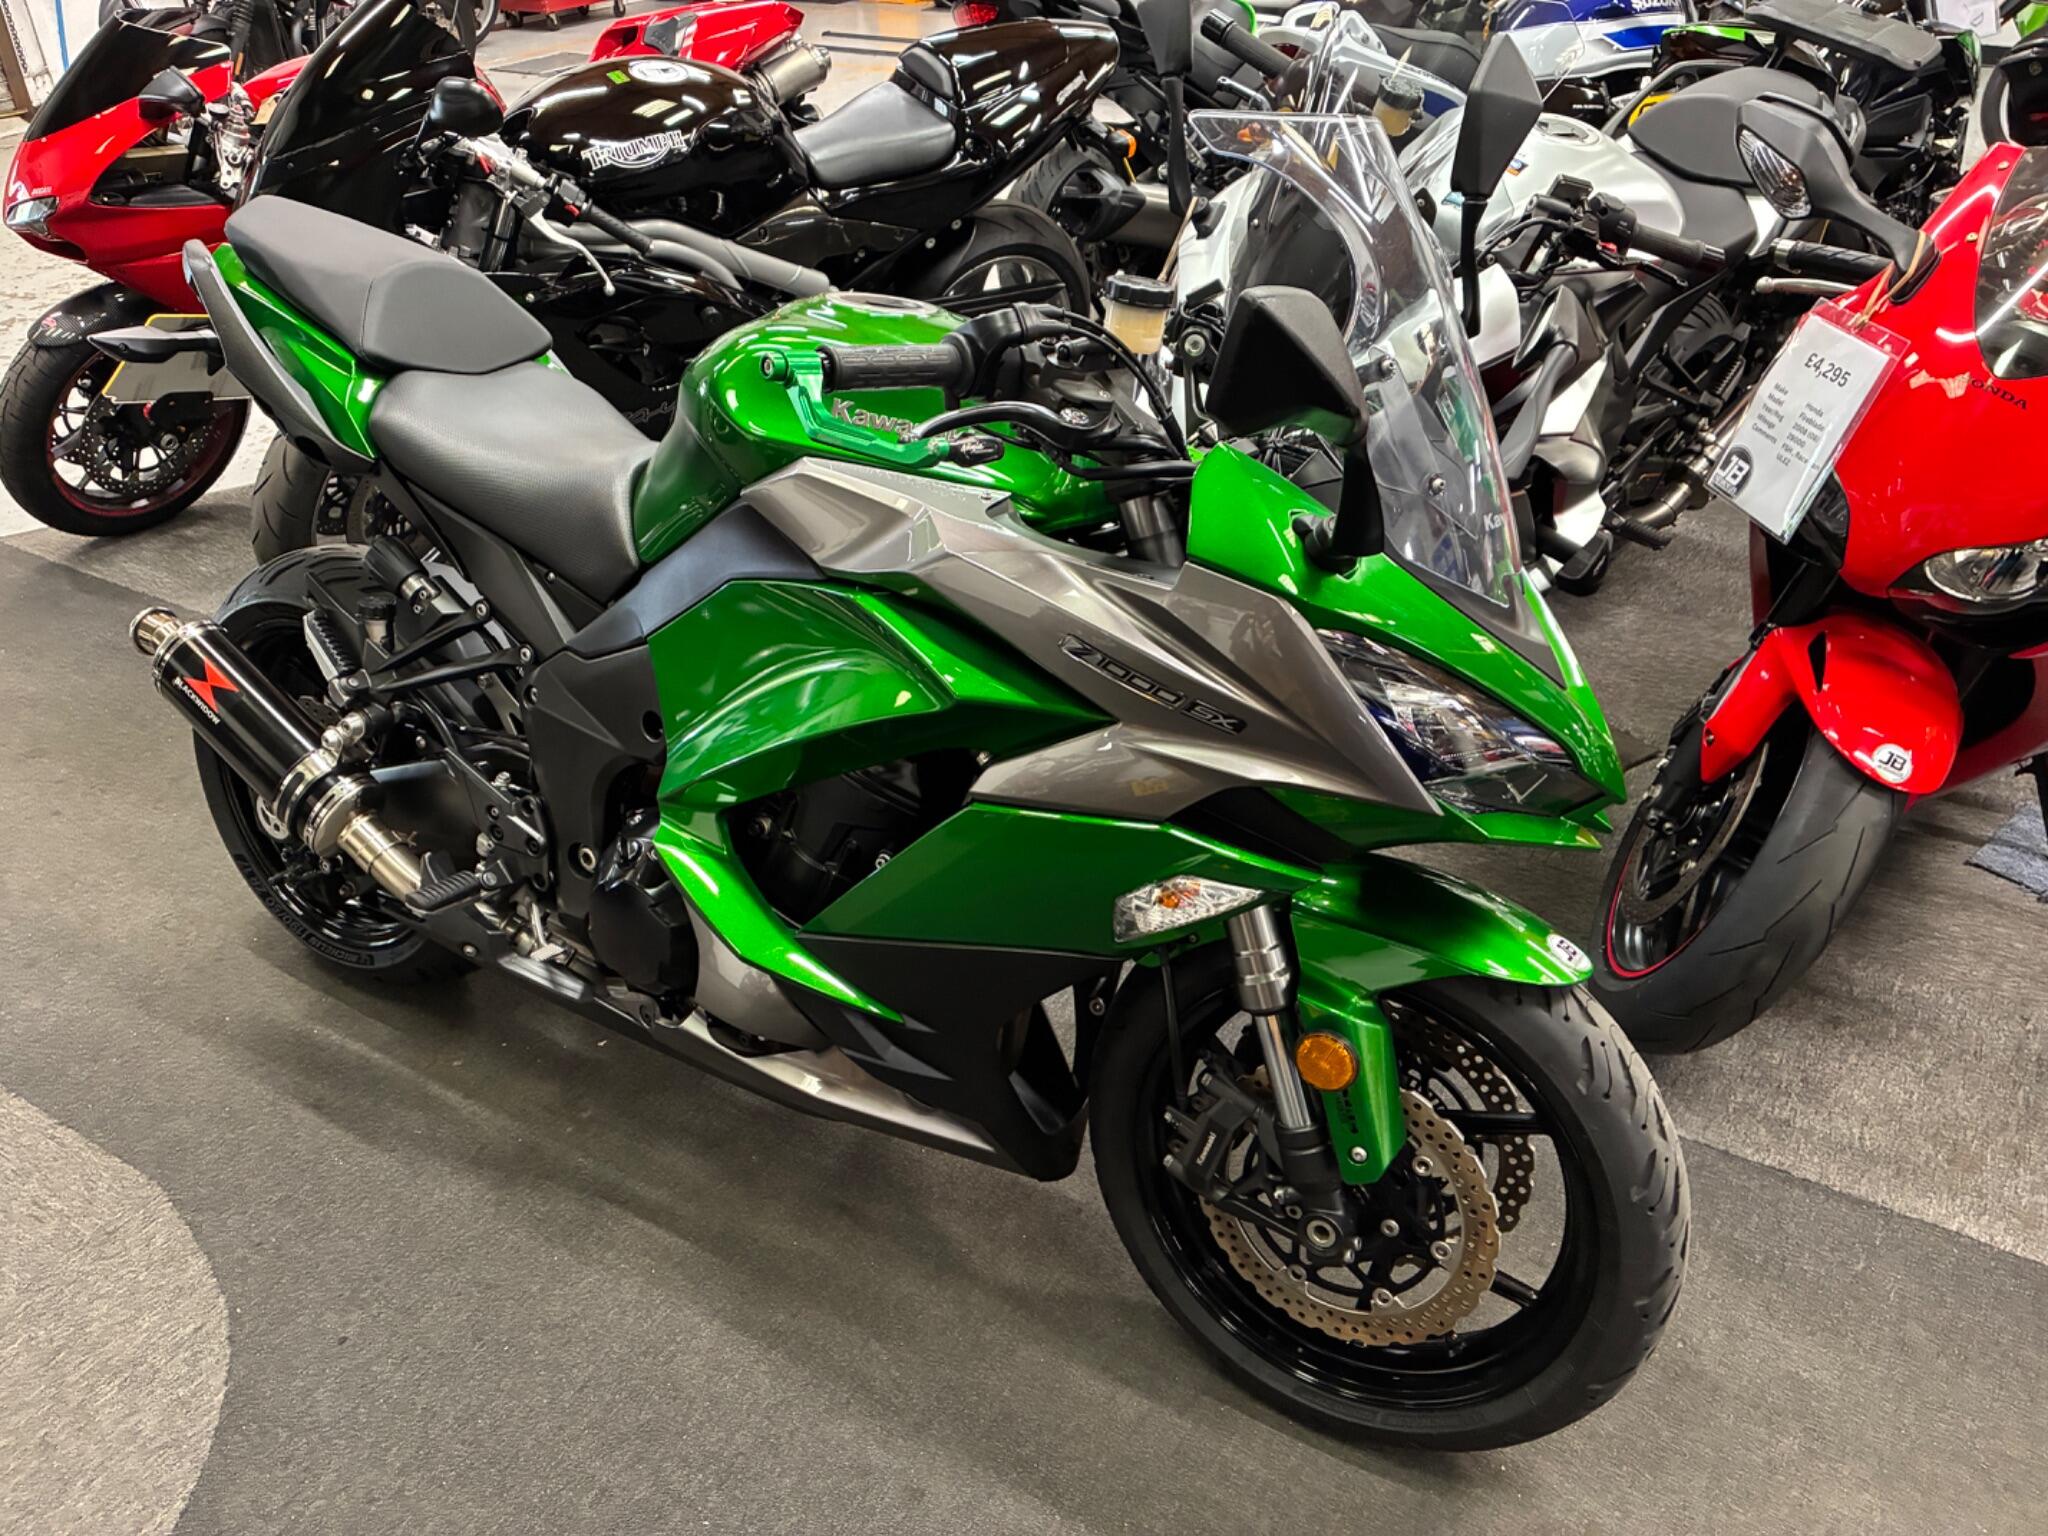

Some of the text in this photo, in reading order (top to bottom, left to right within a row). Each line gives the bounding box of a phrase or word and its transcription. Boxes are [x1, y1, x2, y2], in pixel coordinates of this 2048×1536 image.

[581, 129, 688, 170] TRIUMPH
[1804, 352, 1852, 388] £4,295
[1966, 378, 2028, 410] ONDA
[1719, 454, 1750, 486] JB
[1058, 633, 1187, 710] Z1000
[172, 676, 221, 726] BLACKWIDOW
[1878, 750, 1907, 771] JB
